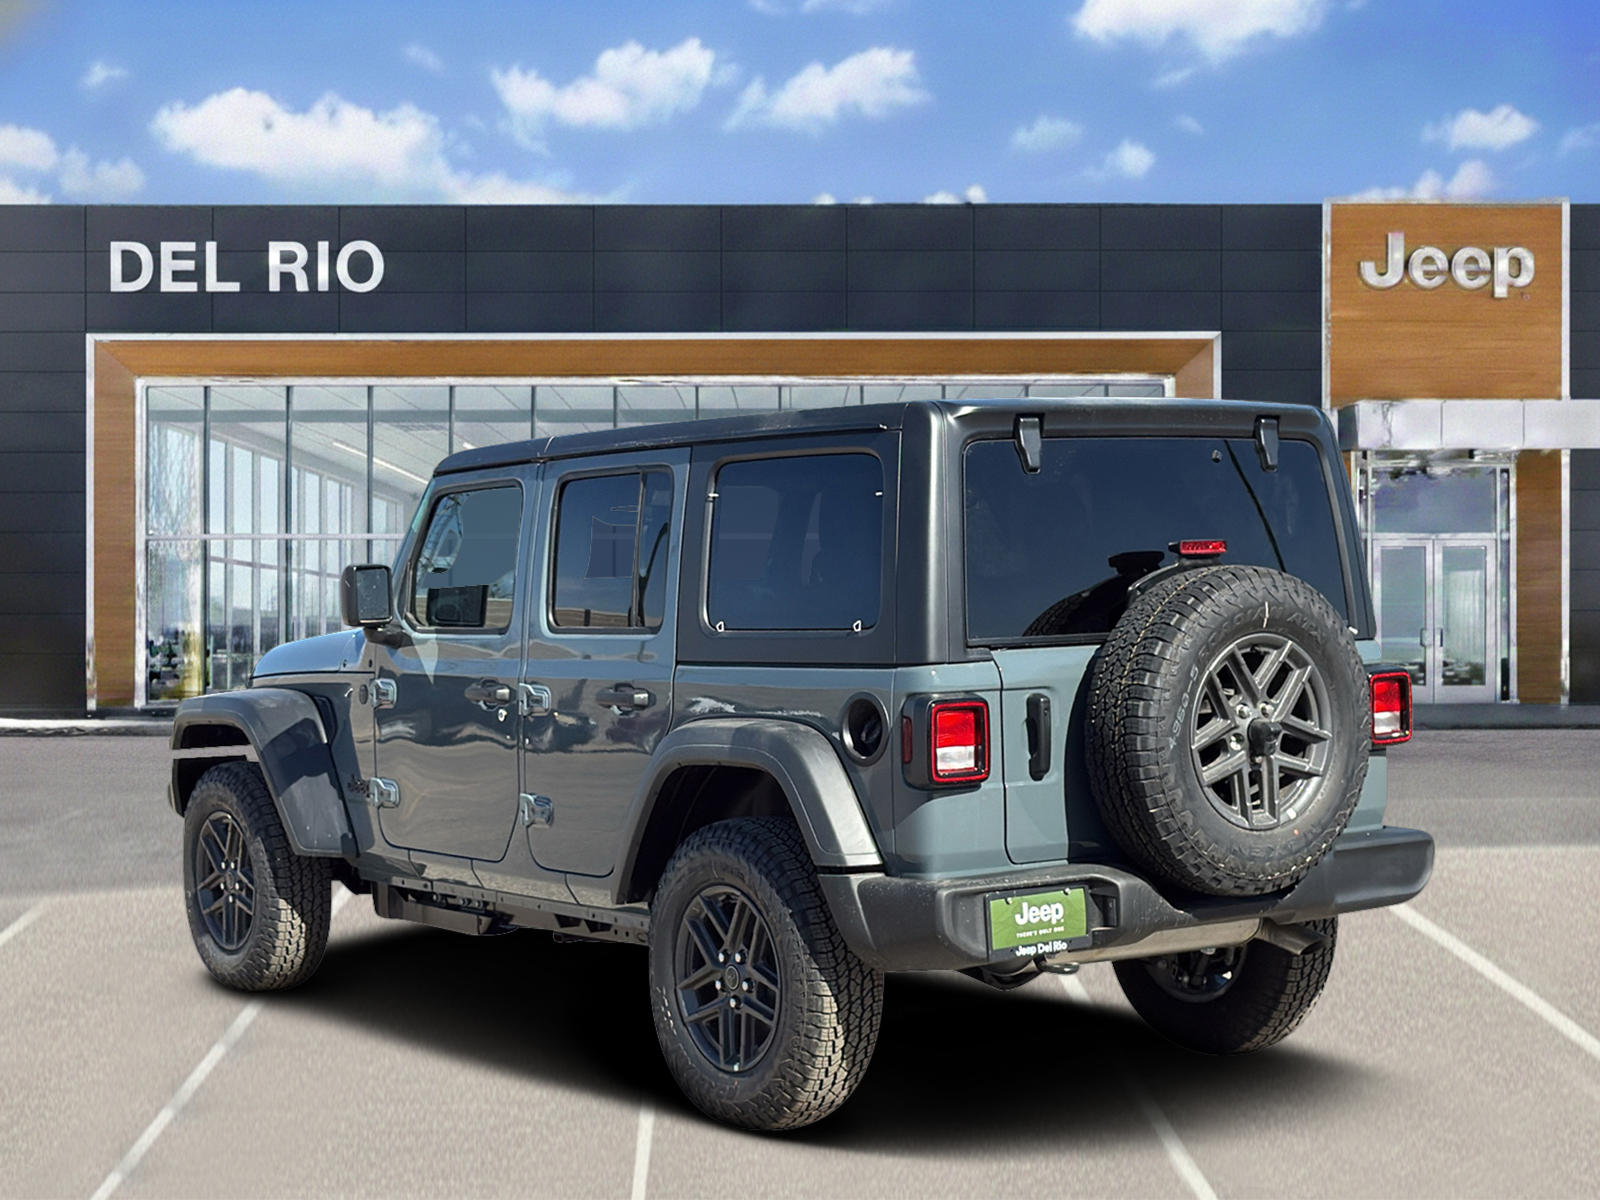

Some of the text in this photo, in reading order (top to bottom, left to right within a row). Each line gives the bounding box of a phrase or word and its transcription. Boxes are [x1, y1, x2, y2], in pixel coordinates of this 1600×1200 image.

[110, 240, 385, 293] DEL RIO
[1360, 231, 1535, 298] Jeep
[1015, 902, 1064, 925] Jeep
[1015, 940, 1068, 957] Jeep Del Rio
